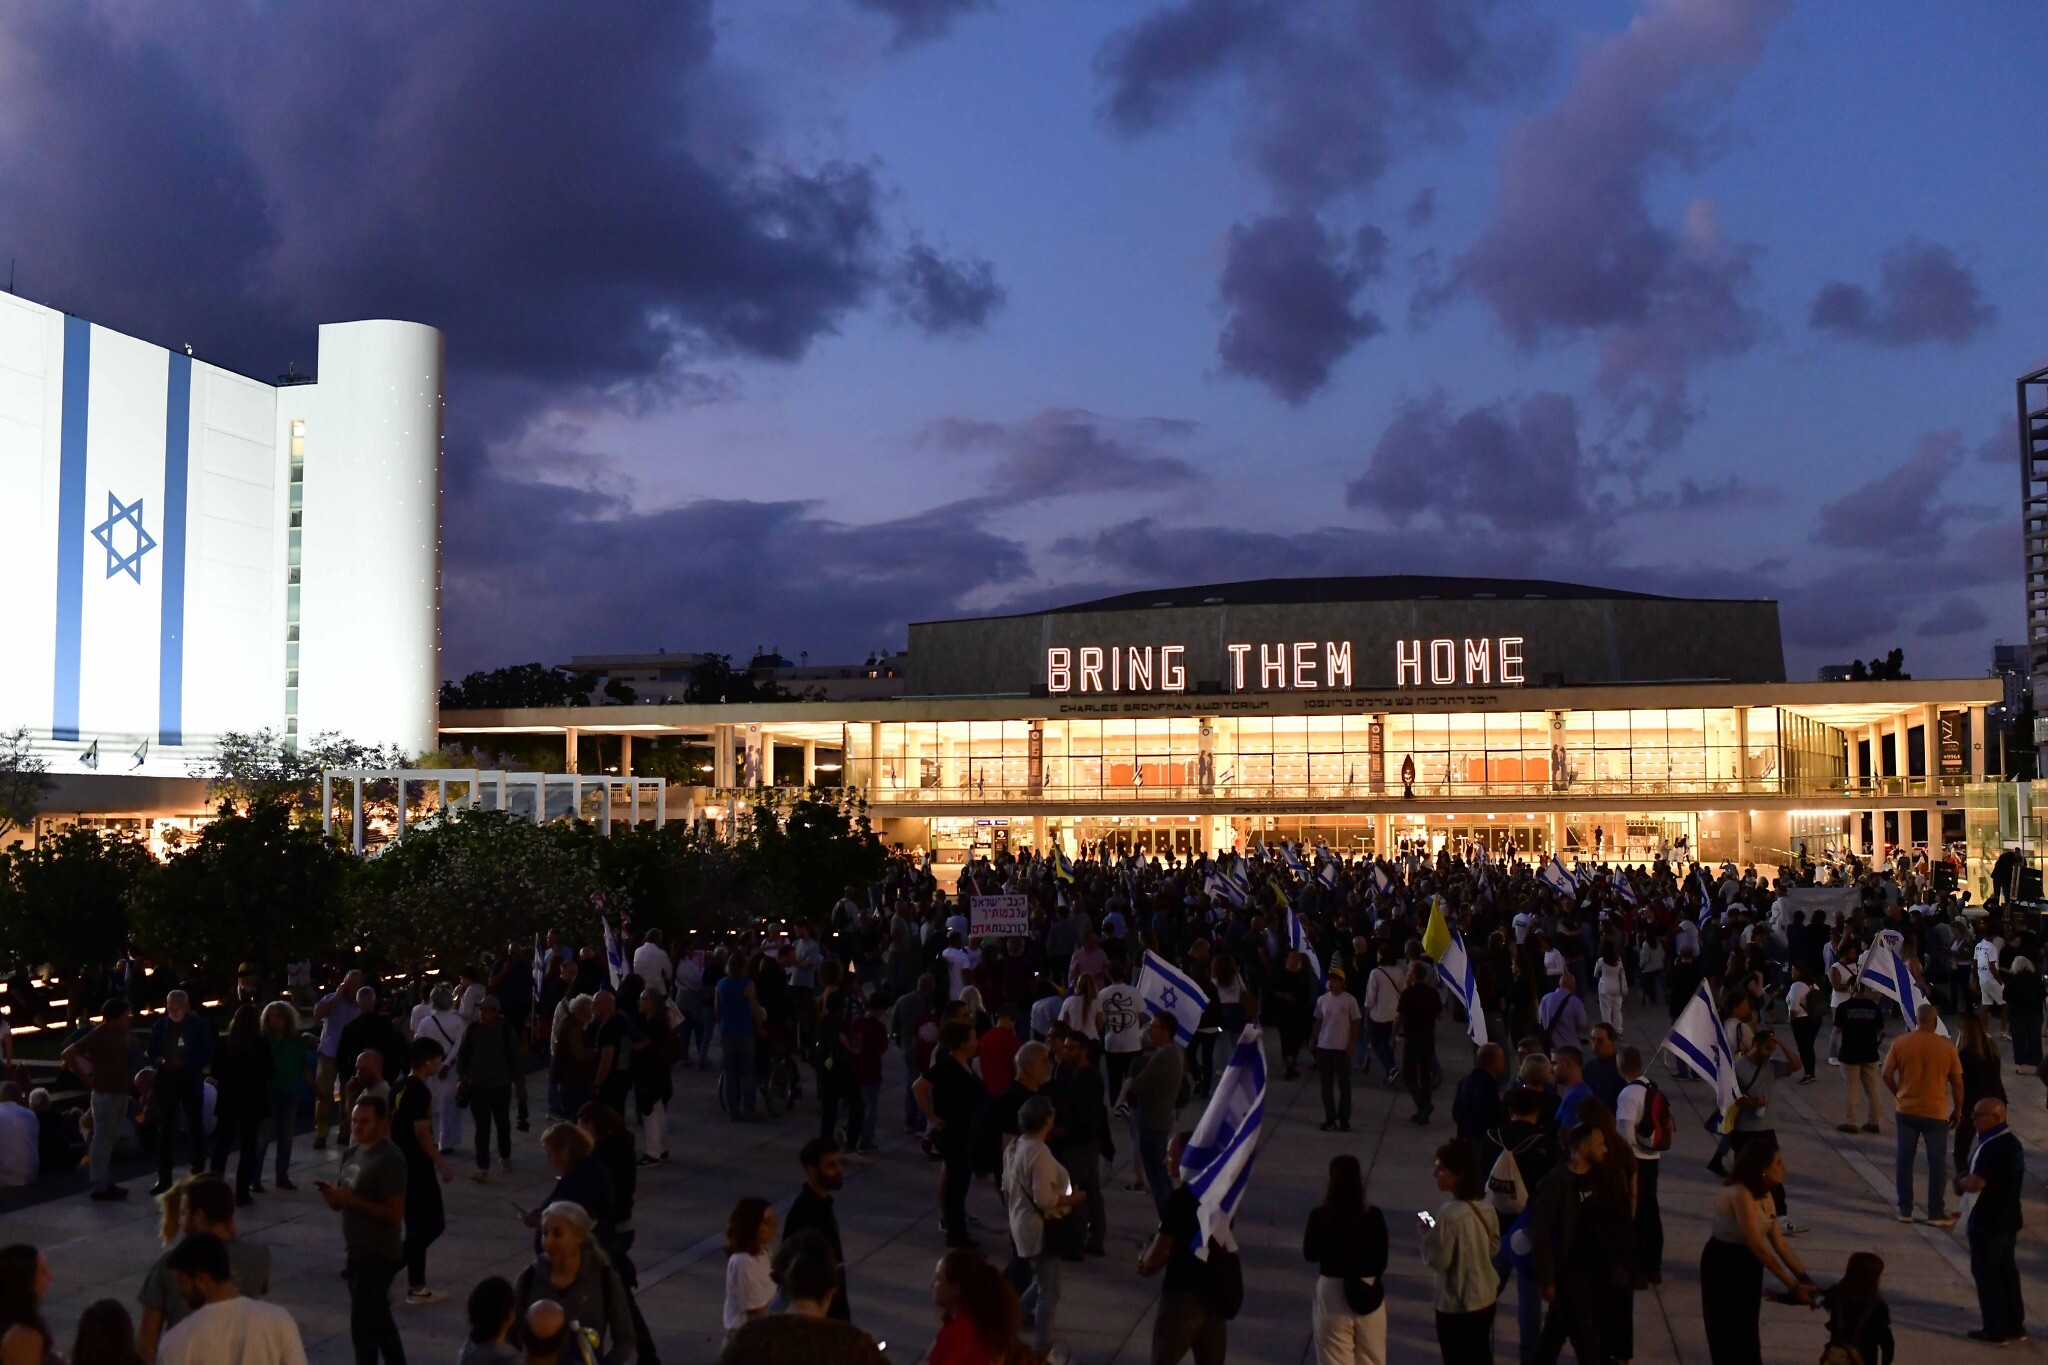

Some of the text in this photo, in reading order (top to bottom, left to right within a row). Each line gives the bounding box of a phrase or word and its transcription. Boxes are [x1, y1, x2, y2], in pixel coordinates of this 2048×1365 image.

[1048, 637, 1524, 692] BRING THEM HOME
[1416, 697, 1465, 706] התרבות
[1467, 695, 1498, 704] היכל
[1059, 701, 1270, 713] CHARLES BRONFMAN AUDITORIUM
[1942, 720, 1960, 746] JAZZ
[972, 898, 1001, 908] ישראל
[982, 908, 1026, 920] על במותיך
[972, 924, 1026, 934] קורבנות אדם
